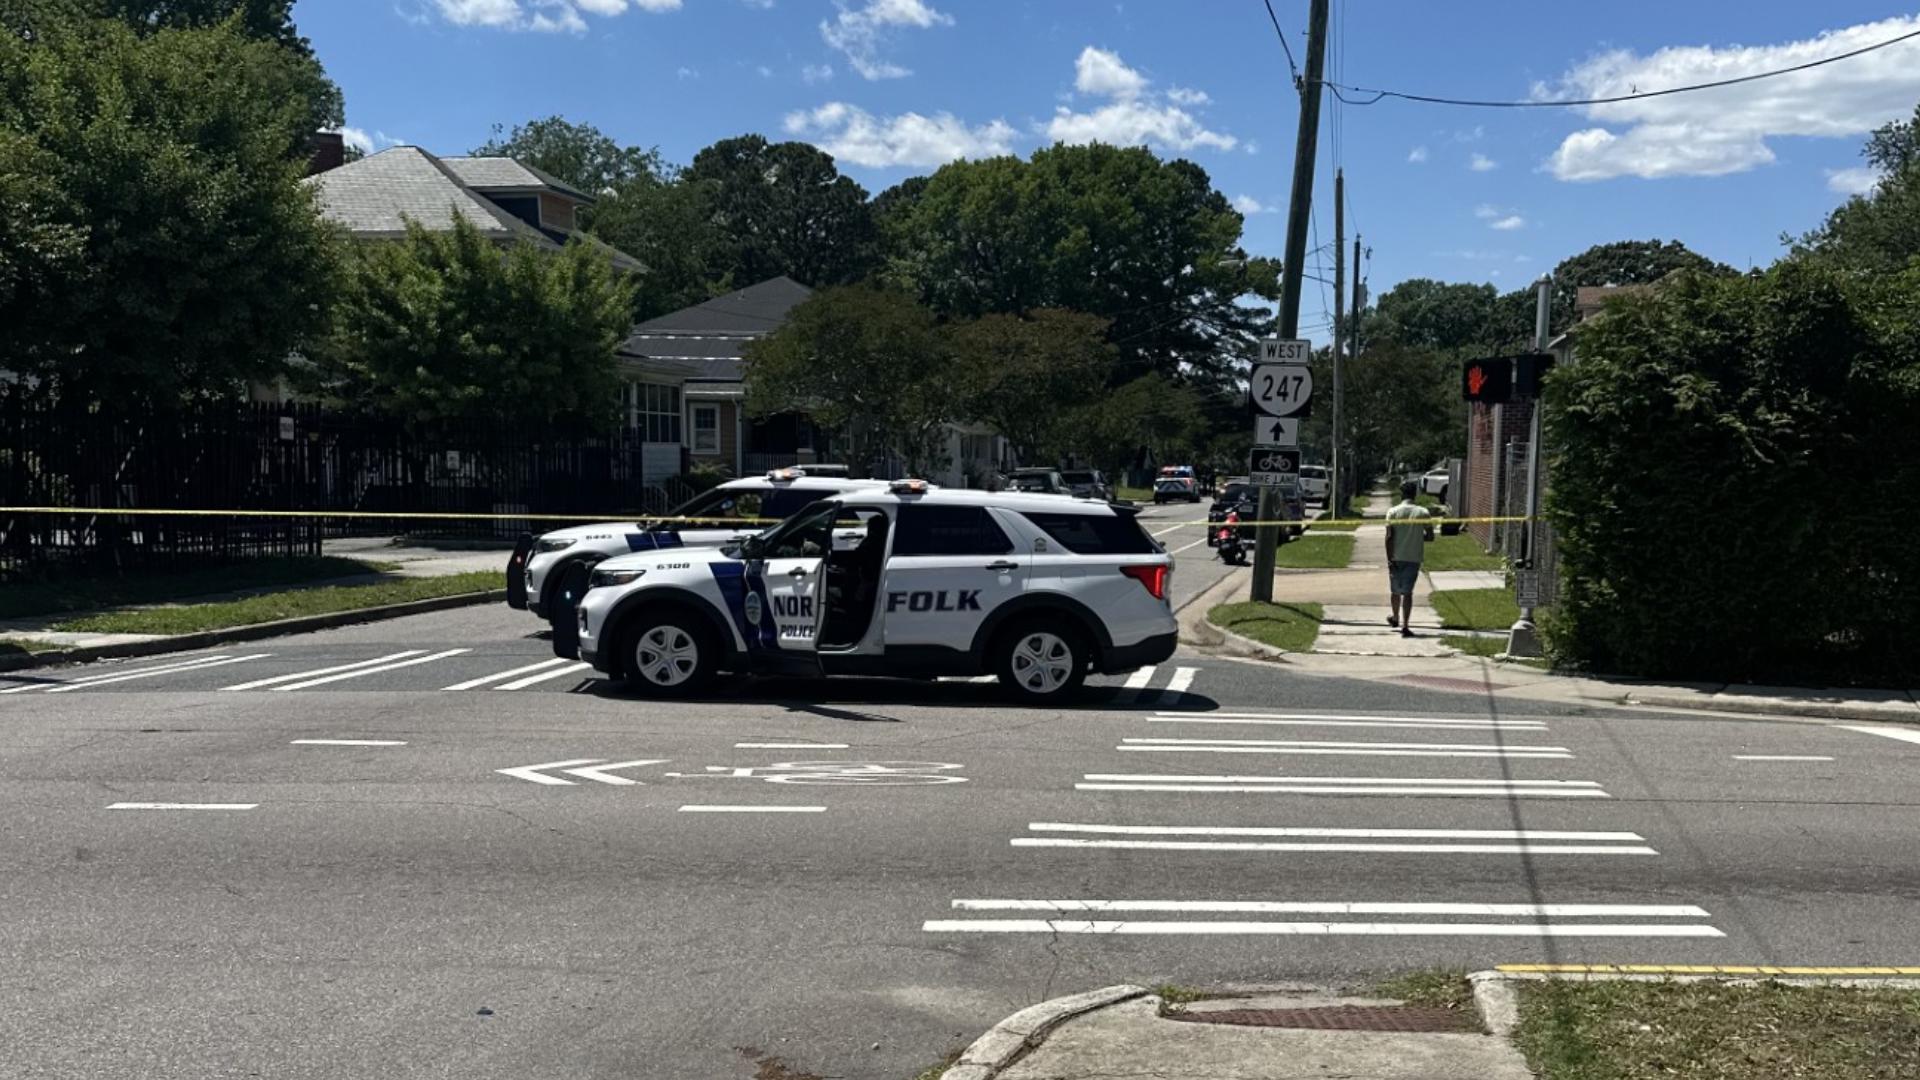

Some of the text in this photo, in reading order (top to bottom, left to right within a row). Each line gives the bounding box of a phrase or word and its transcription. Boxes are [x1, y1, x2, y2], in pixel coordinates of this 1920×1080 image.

[1266, 344, 1303, 359] WEST
[1262, 374, 1304, 403] 247
[656, 562, 691, 571] 6308
[774, 590, 983, 617] NOR FOLK
[781, 624, 816, 638] POLICE
